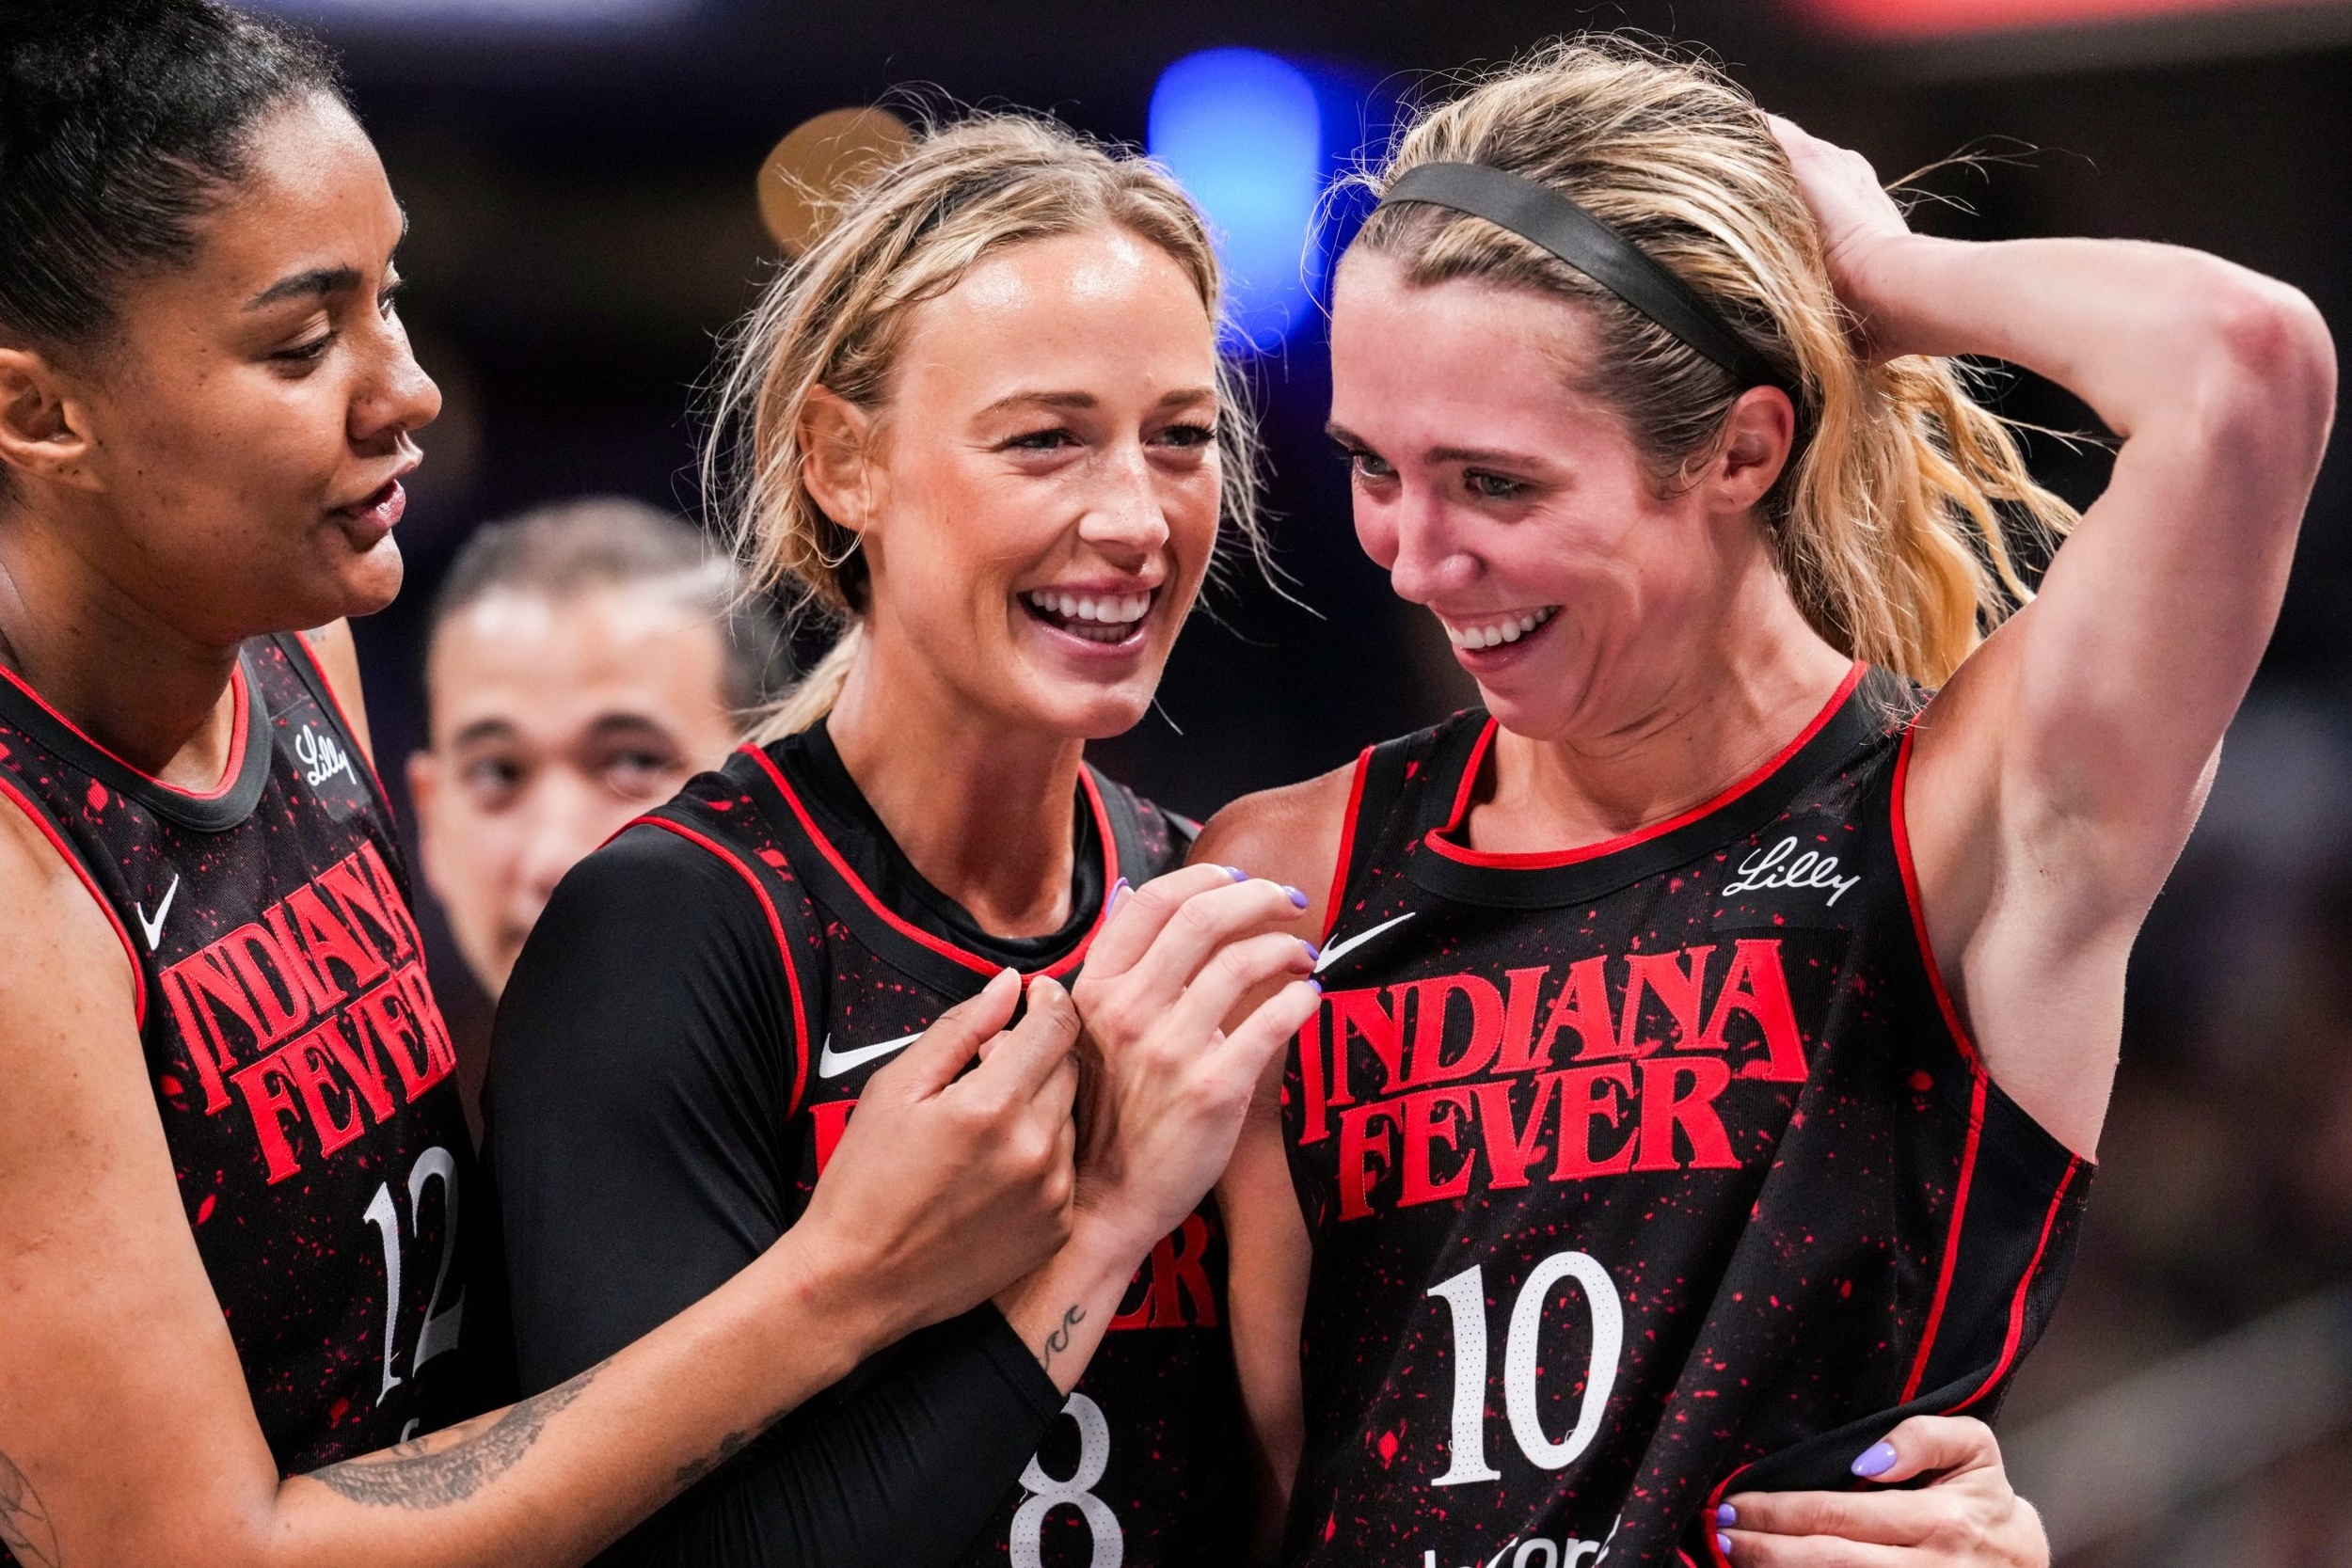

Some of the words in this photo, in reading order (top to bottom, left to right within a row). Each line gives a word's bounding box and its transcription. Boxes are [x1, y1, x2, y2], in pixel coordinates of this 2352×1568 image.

[294, 723, 358, 786] Lilly
[159, 839, 429, 1116] INDIANA
[1722, 835, 1862, 907] Lilly
[230, 959, 457, 1180] FEVER
[1298, 938, 1808, 1146] INDIANA
[1339, 1055, 1742, 1222] FEVER
[363, 1146, 467, 1409] 12
[1426, 1250, 1624, 1486] 10
